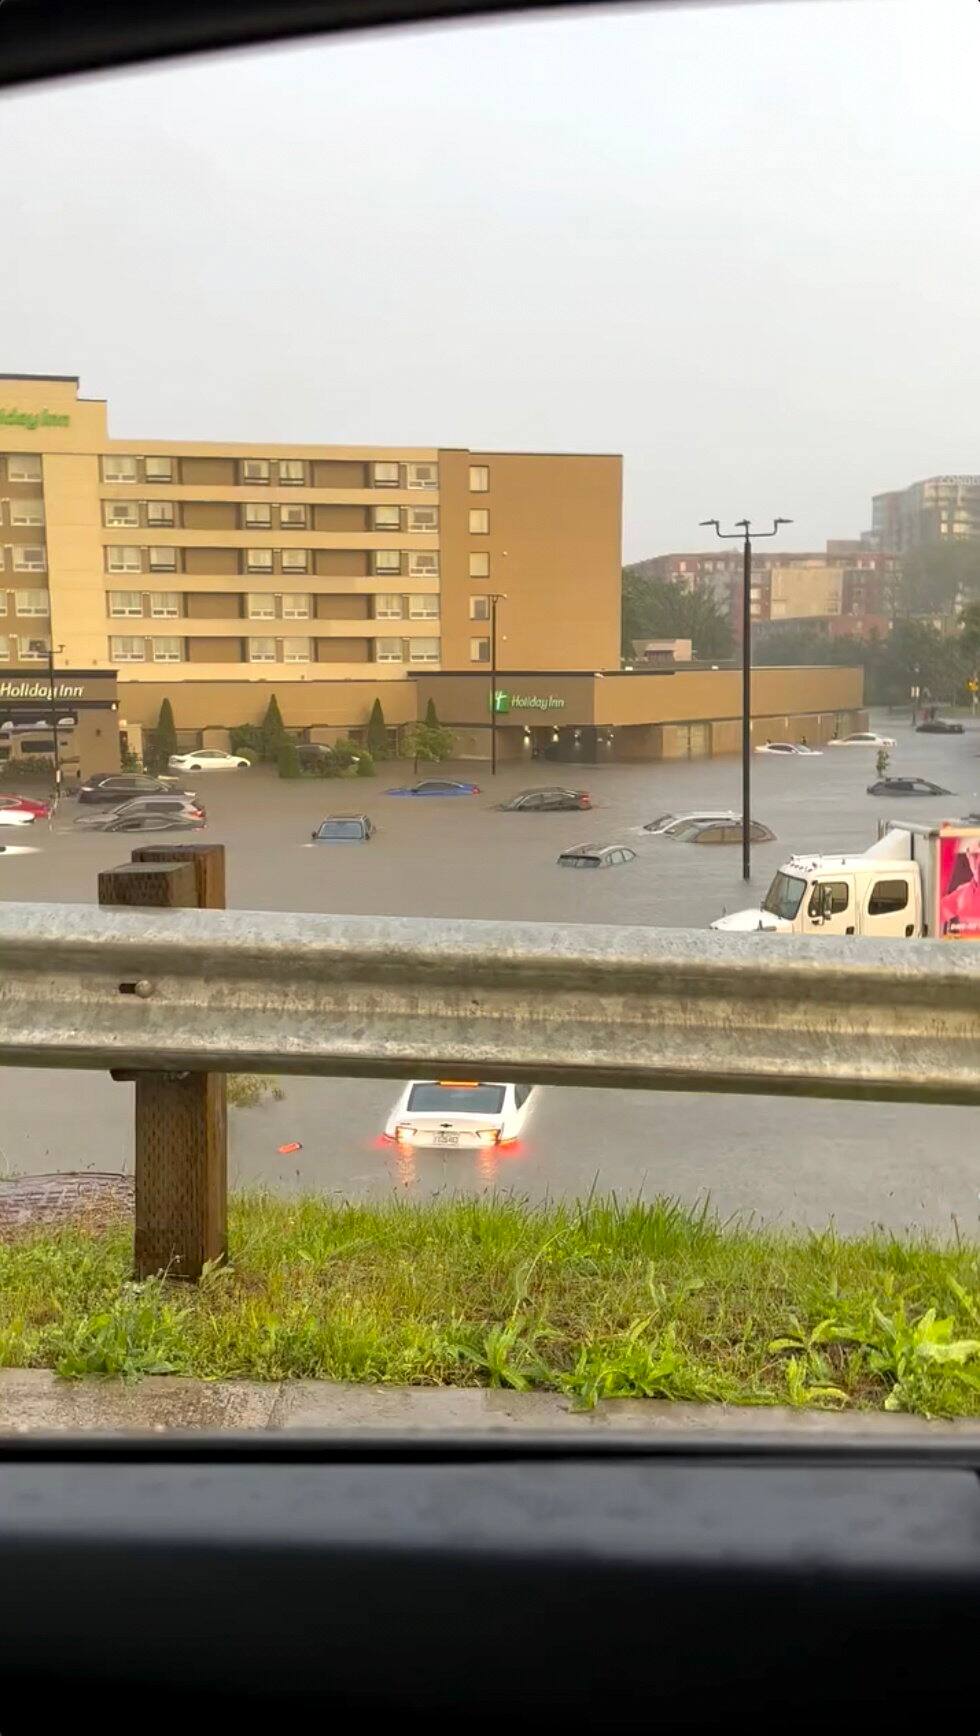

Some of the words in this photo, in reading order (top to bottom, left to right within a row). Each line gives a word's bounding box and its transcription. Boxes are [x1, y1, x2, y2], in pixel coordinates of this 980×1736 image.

[0, 682, 58, 700] Holiday
[59, 684, 85, 699] Inn
[511, 694, 549, 711] Holiday
[548, 694, 565, 708] Inn
